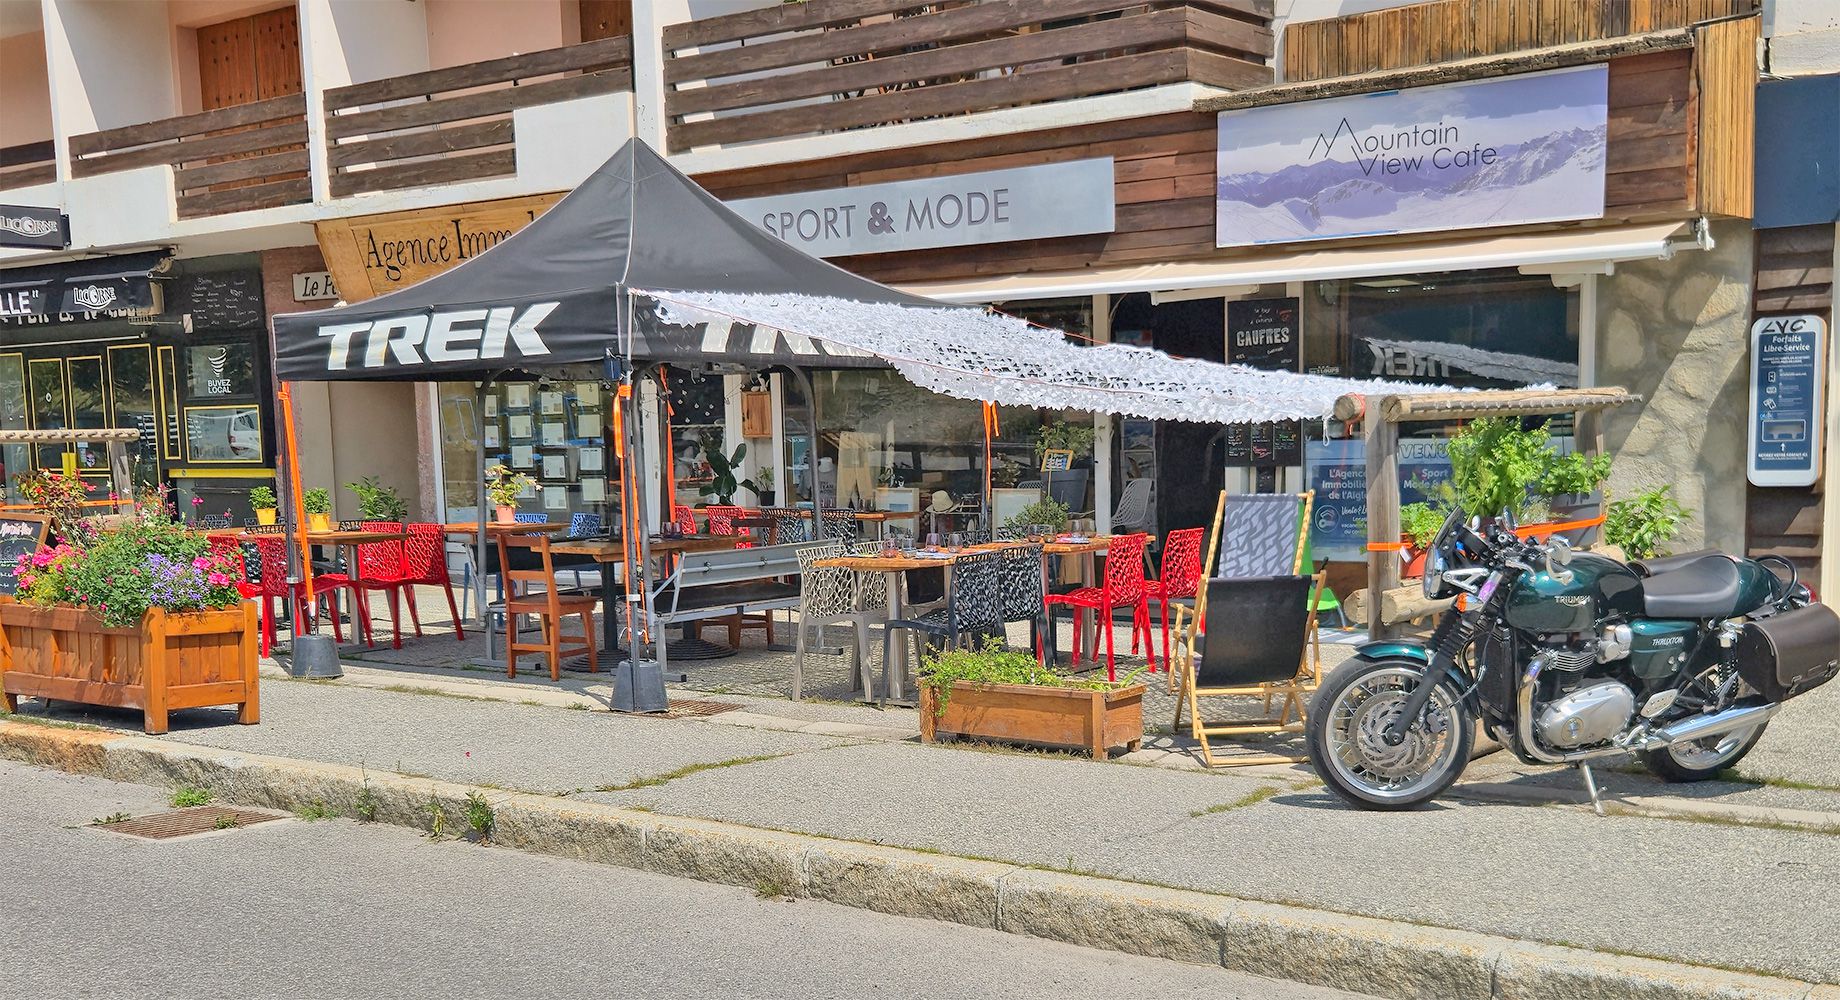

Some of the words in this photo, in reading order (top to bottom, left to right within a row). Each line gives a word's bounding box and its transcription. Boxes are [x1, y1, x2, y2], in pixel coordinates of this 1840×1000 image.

[1309, 117, 1458, 159] Mountain
[1351, 145, 1423, 176] View
[1432, 143, 1497, 170] Cafe
[762, 204, 856, 242] SPORT
[867, 201, 896, 235] &
[905, 188, 1009, 232] MODE
[366, 228, 450, 281] Agence
[74, 285, 117, 305] LICORNE
[302, 276, 319, 297] Le
[318, 301, 561, 371] TREK
[1236, 327, 1290, 347] GAUFRES
[1772, 335, 1802, 344] Forfaits
[1763, 344, 1810, 353] Libre-Service
[207, 379, 231, 387] BUVEZ
[208, 386, 232, 394] LOCAL
[1421, 468, 1448, 478] Sport
[1328, 491, 1340, 500] de
[1554, 595, 1591, 606] TRIUMPH
